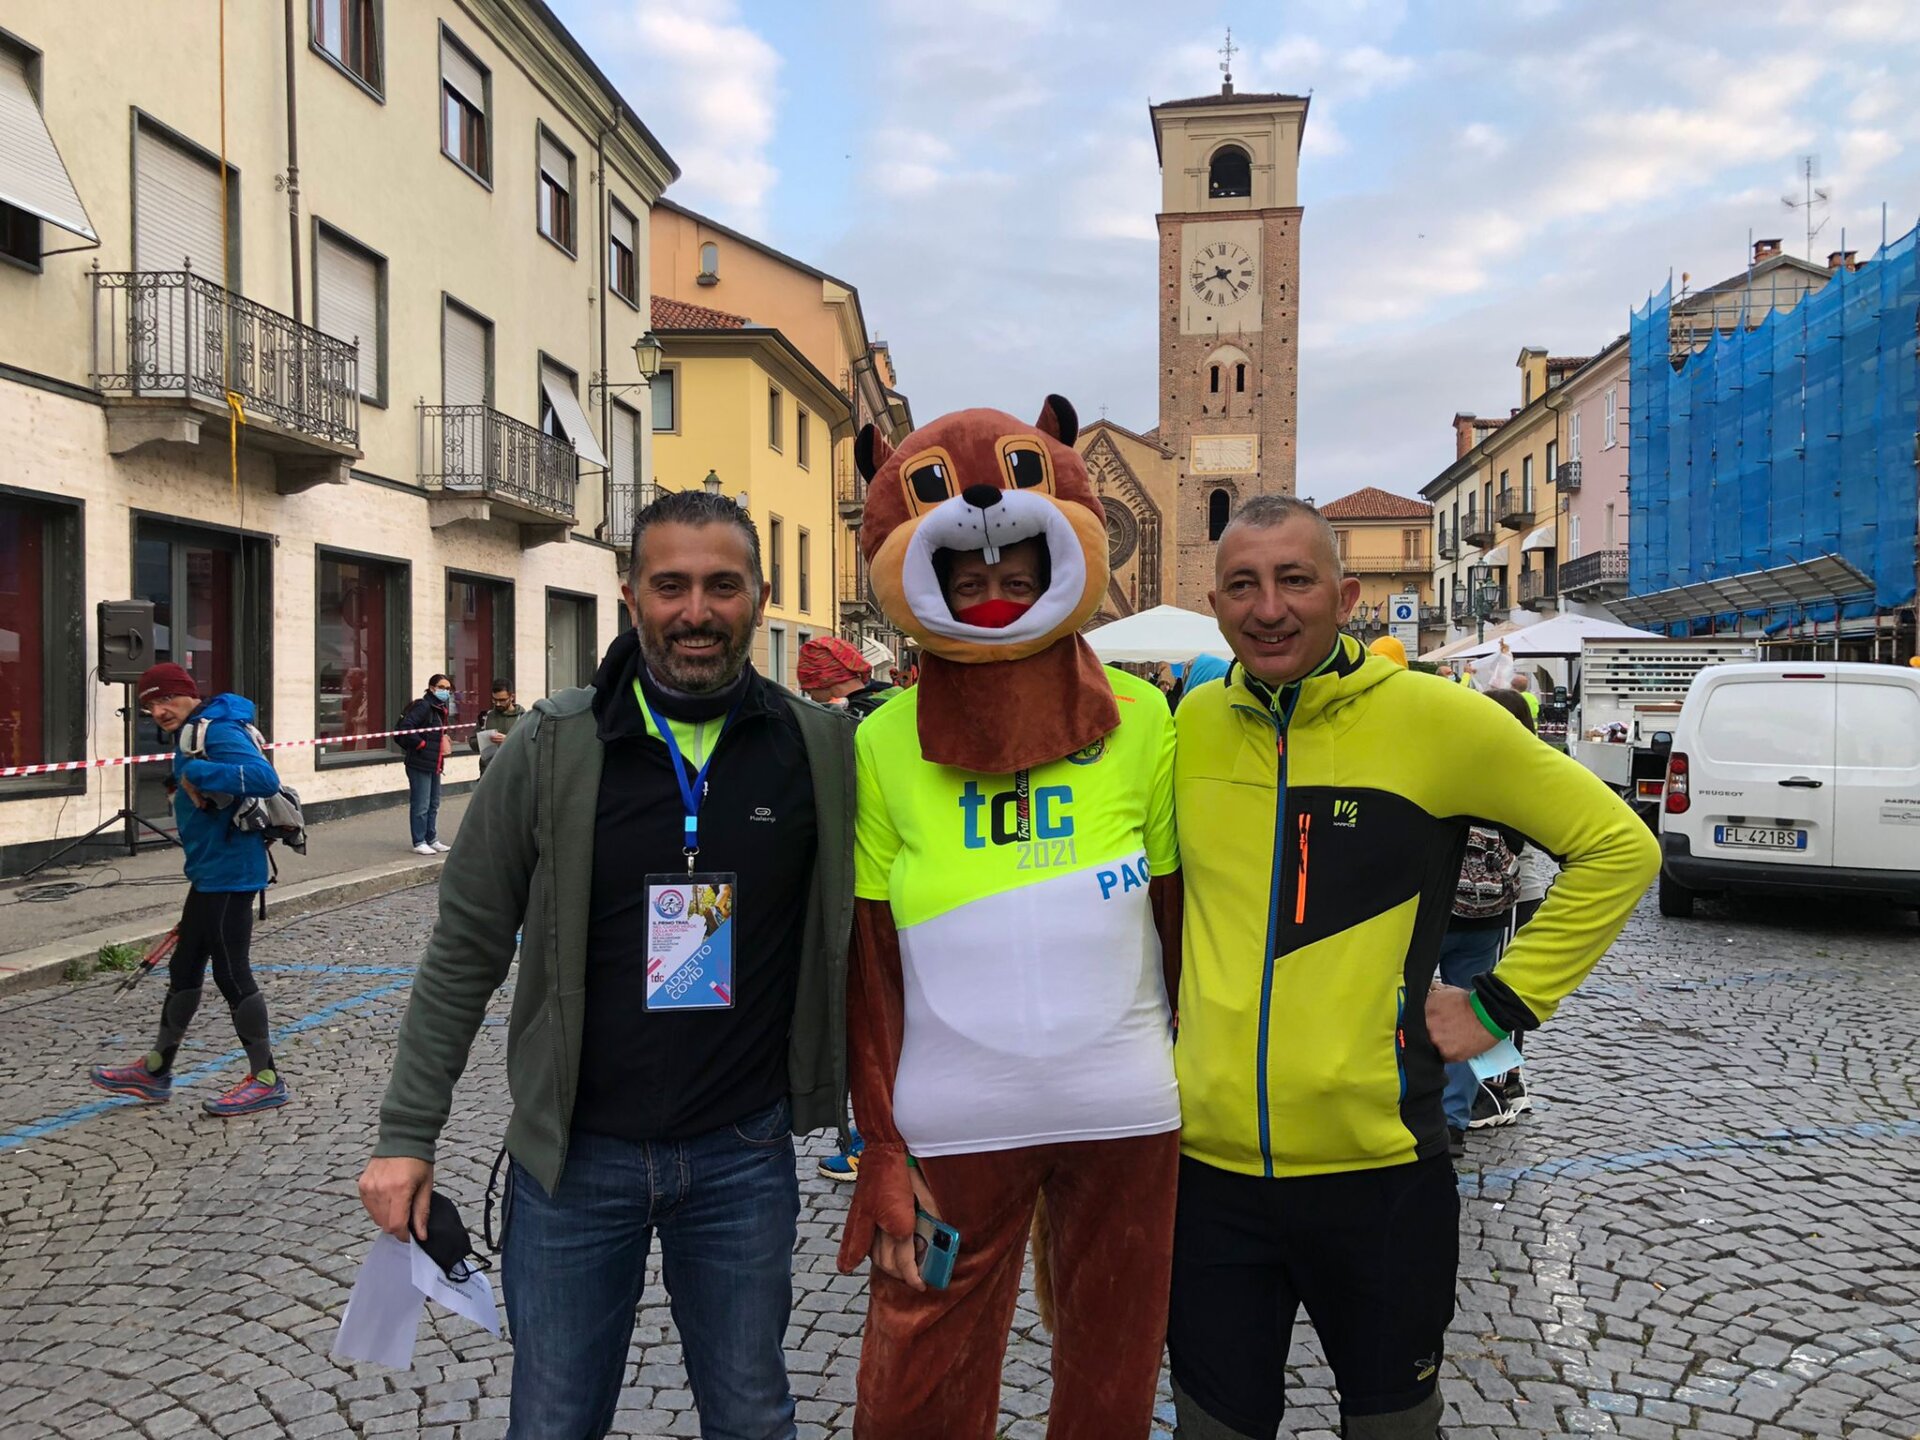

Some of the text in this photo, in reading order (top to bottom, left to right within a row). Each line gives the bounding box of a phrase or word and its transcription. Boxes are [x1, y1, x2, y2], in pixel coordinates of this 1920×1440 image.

[1698, 789, 1744, 797] PEUGEOT
[1016, 838, 1077, 870] 2021
[664, 944, 712, 994] ADDETTO
[671, 967, 704, 1000] COVID
